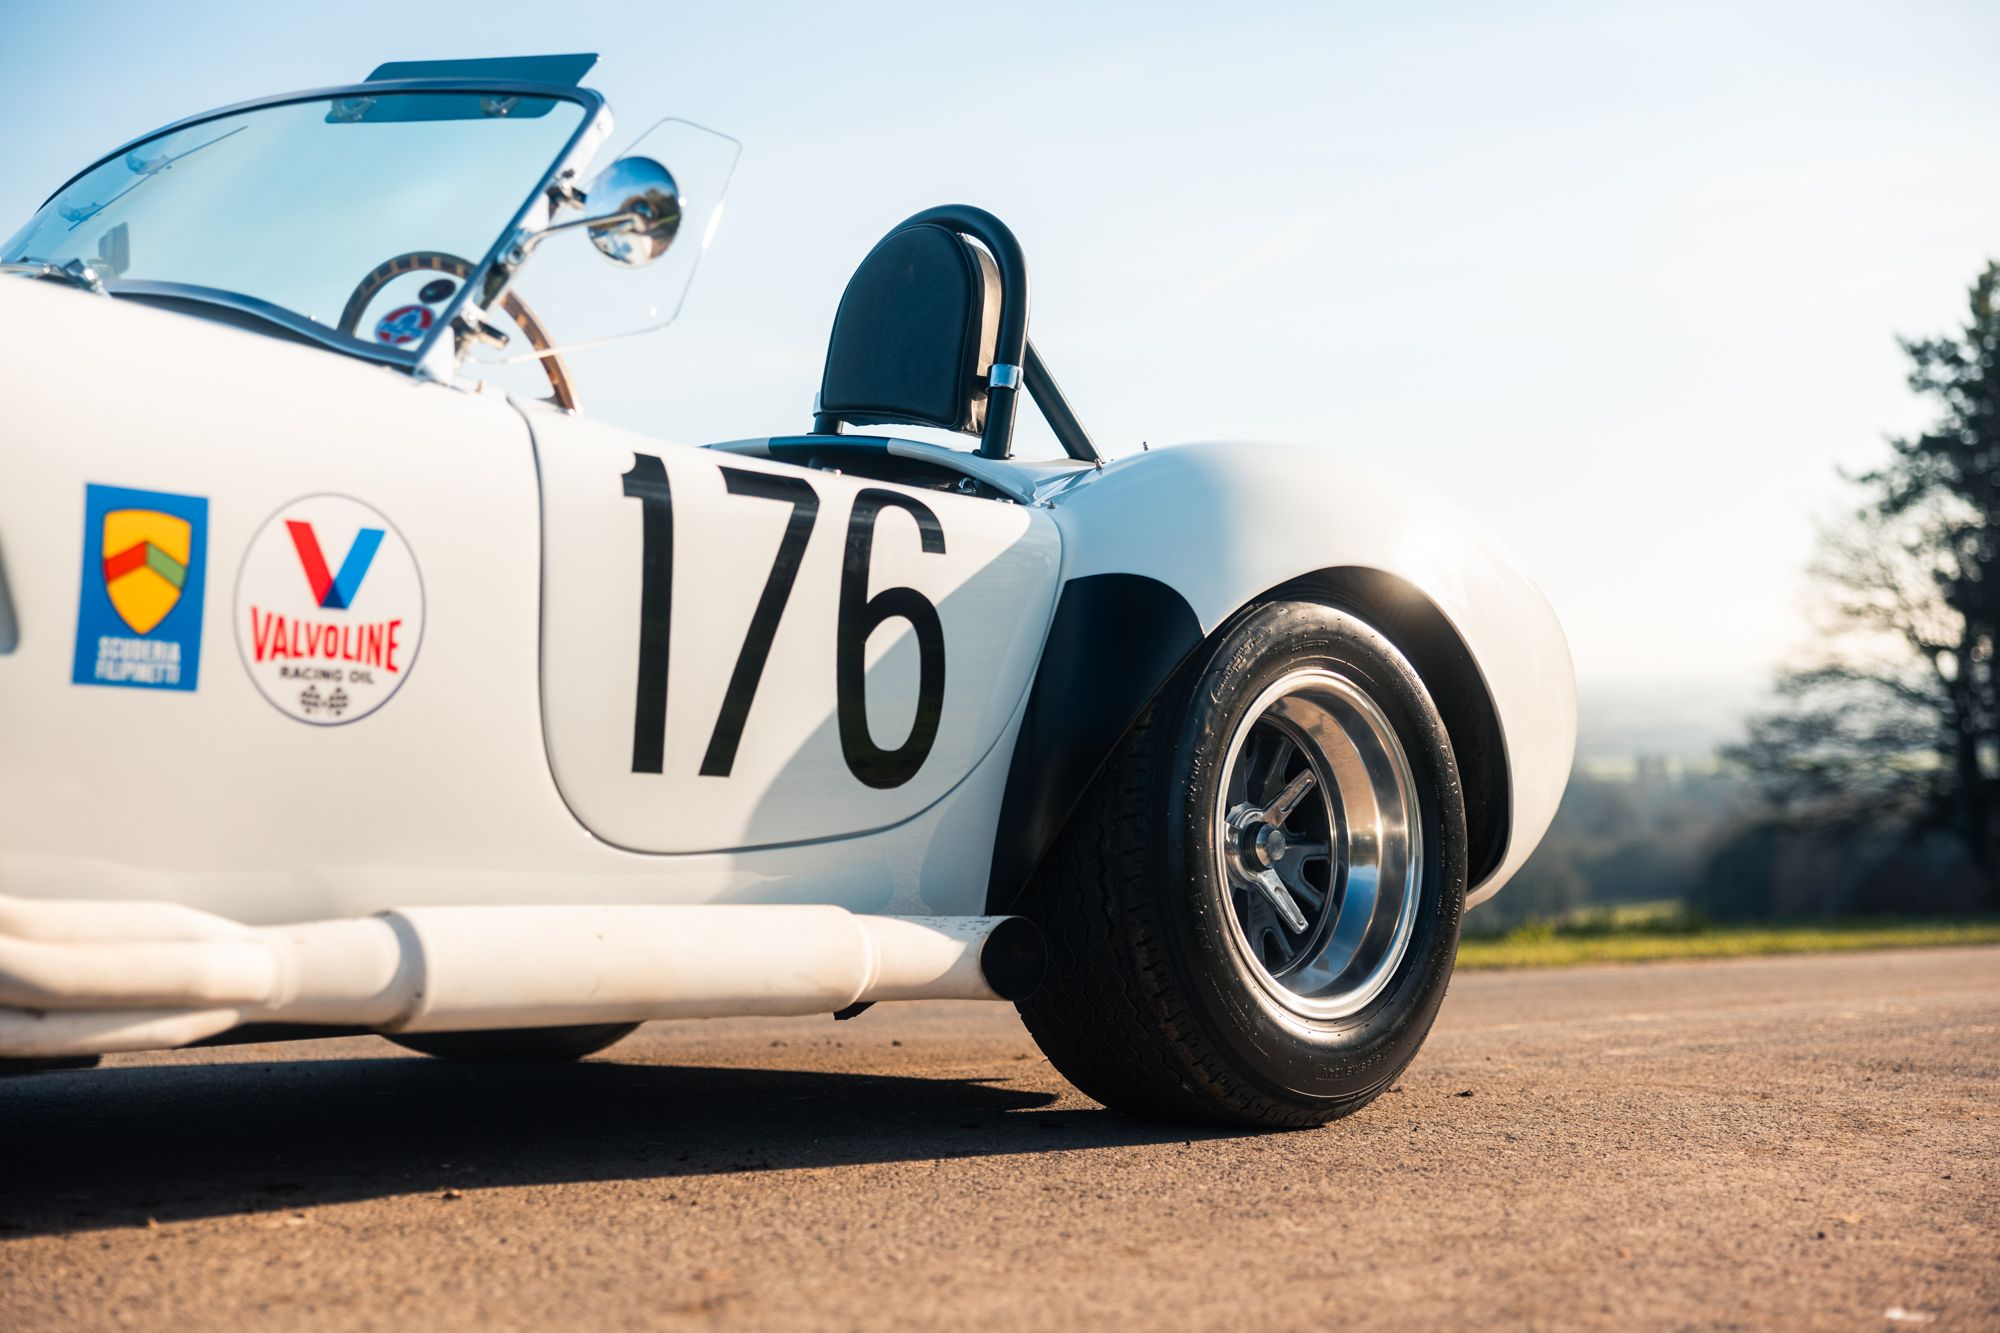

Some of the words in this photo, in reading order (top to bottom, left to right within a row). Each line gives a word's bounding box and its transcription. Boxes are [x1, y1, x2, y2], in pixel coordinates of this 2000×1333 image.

[251, 606, 402, 674] VALVOLINE
[622, 452, 947, 790] 176
[280, 665, 343, 682] RACING
[349, 670, 376, 684] OIL
